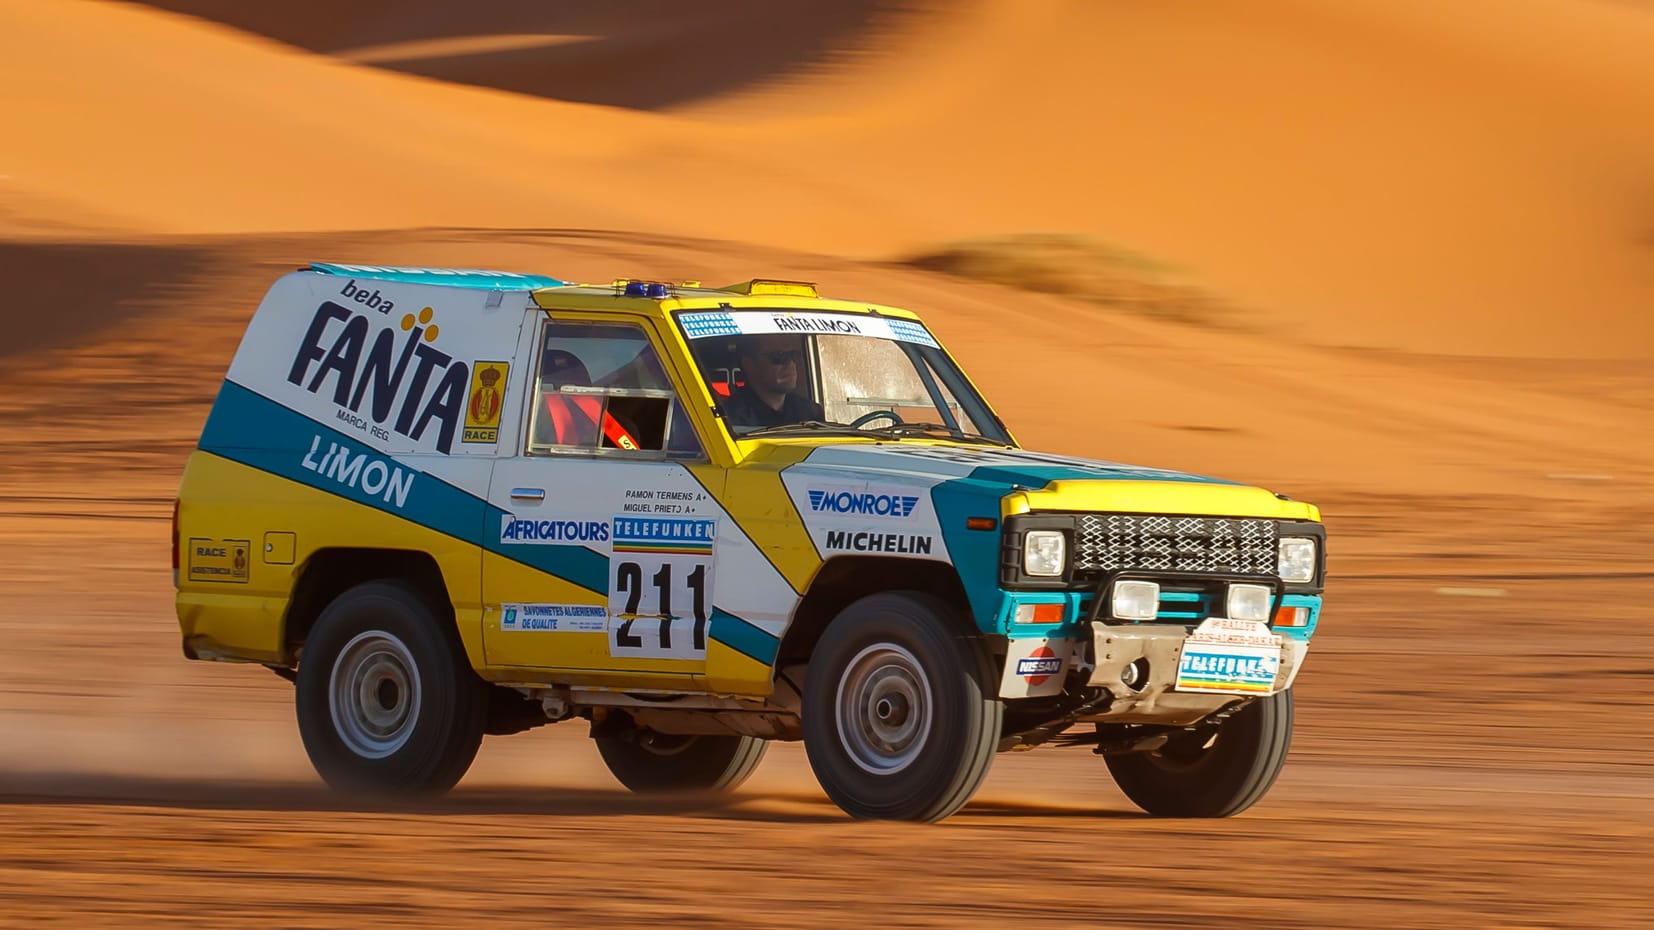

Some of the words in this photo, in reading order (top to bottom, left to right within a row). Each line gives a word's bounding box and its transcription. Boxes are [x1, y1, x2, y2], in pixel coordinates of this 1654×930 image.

[340, 279, 394, 315] beba
[773, 316, 815, 331] FANTA
[811, 318, 862, 334] LIMON
[287, 300, 470, 456] FANTA
[336, 409, 367, 432] MARCA
[464, 431, 496, 440] RACE
[301, 435, 415, 509] LIMON
[625, 490, 654, 499] RAMON
[656, 491, 693, 501] TERMENS
[820, 492, 902, 517] MONROE
[623, 503, 651, 512] MIGUEL
[502, 519, 609, 542] AFRICATOURS
[615, 521, 714, 539] TELEFUNKEN
[197, 547, 226, 557] RACE
[826, 531, 932, 554] MICHELIN
[616, 562, 705, 650] 211
[522, 619, 531, 629] DE
[531, 619, 558, 630] QUALITE
[1019, 660, 1060, 672] NISSAN
